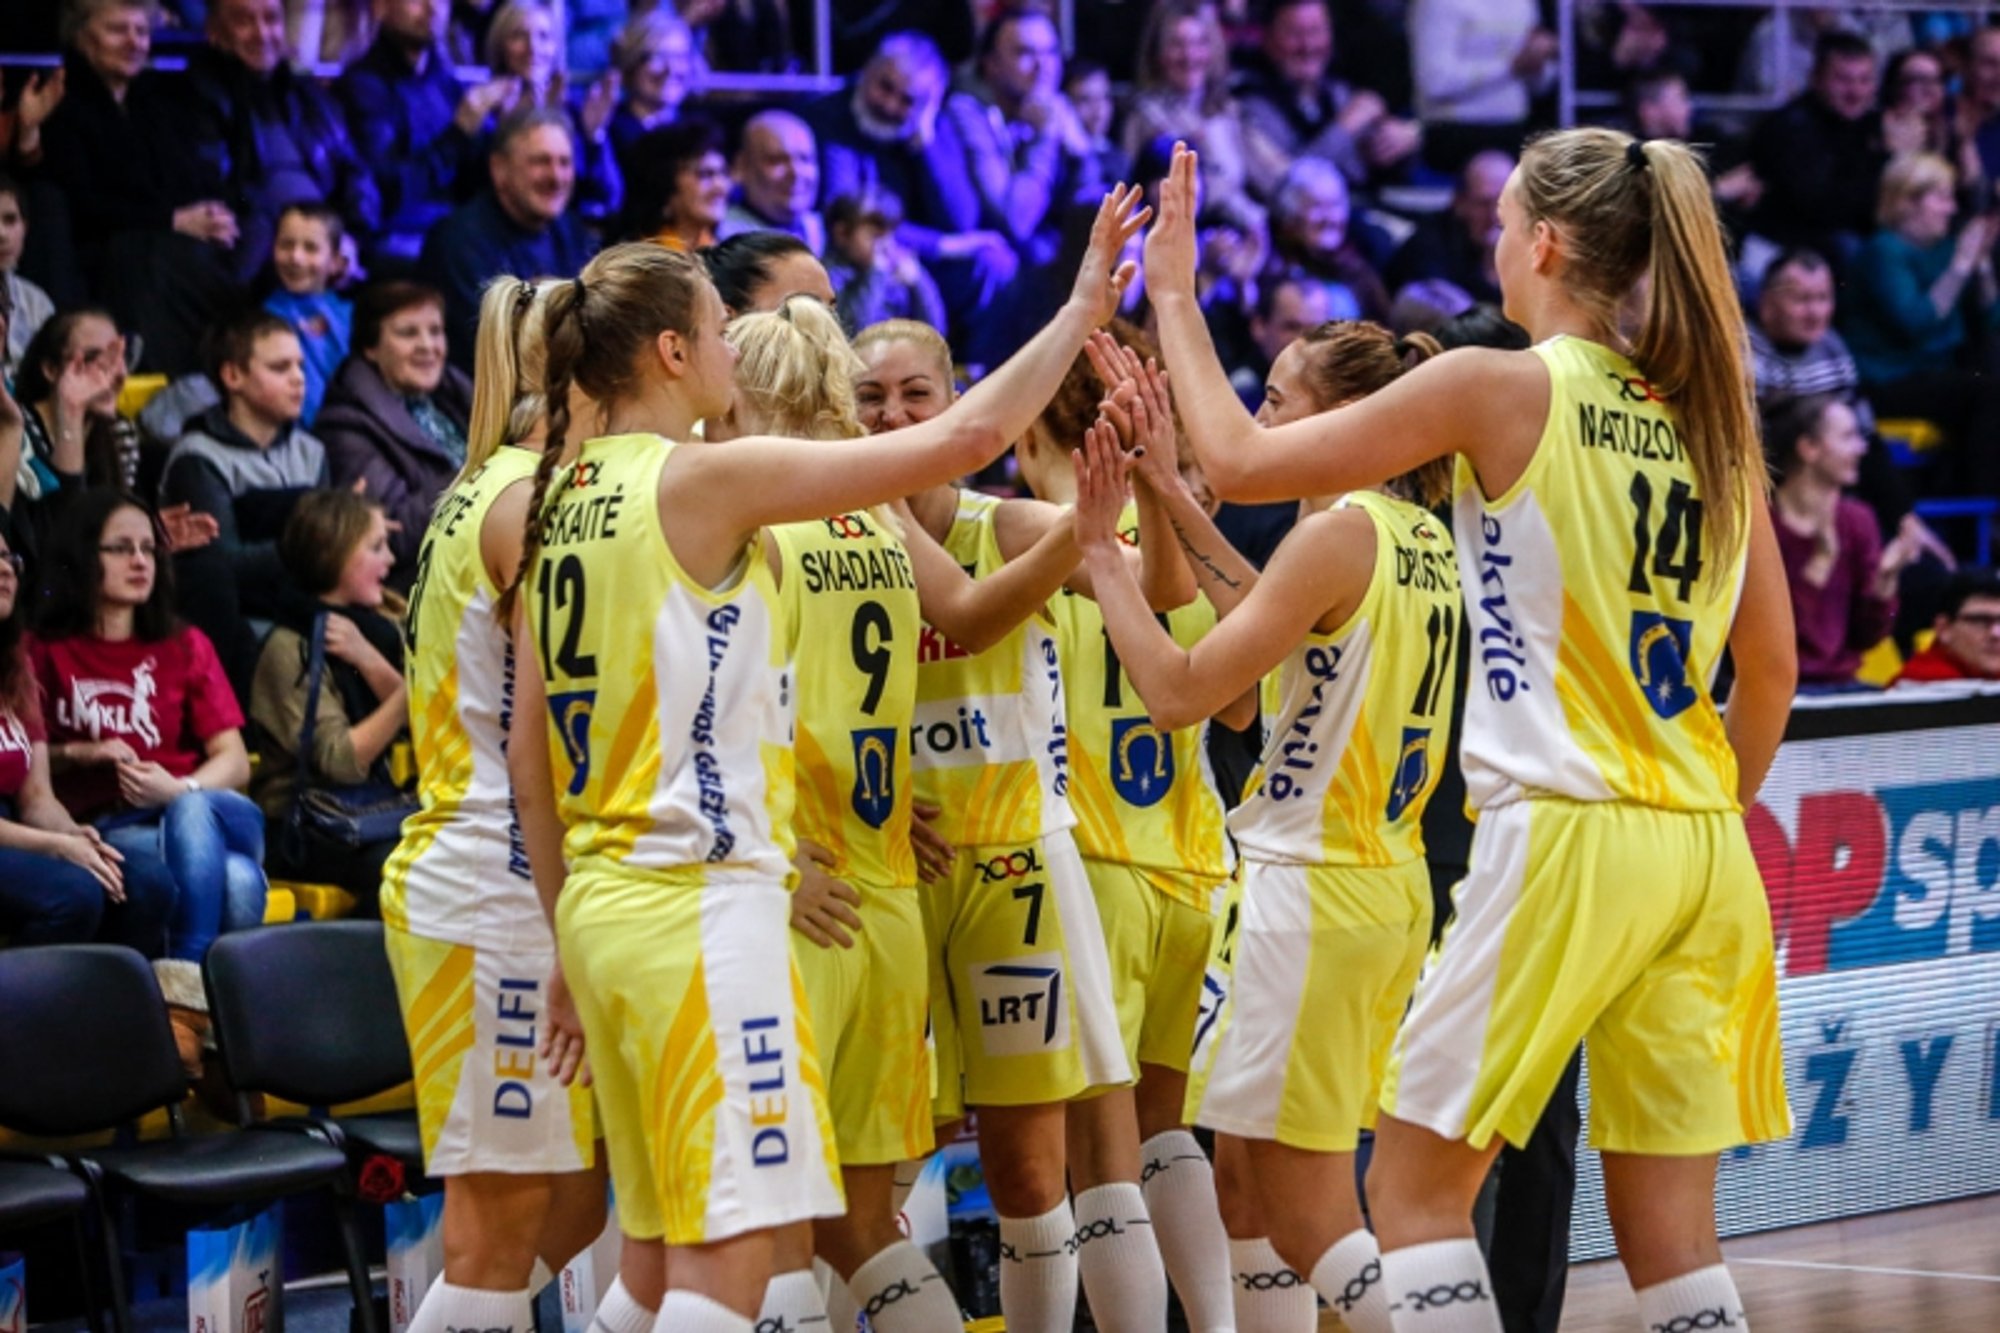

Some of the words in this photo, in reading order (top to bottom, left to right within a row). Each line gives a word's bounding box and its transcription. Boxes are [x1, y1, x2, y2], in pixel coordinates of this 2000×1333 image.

[541, 483, 624, 547] SKAITĖ
[1627, 470, 1703, 603] 14
[538, 553, 598, 681] 12
[852, 600, 893, 716] 9
[1410, 604, 1454, 717] 11
[910, 706, 991, 754] roit
[1012, 882, 1044, 945] 7
[493, 978, 538, 1119] DELFI
[981, 991, 1045, 1026] LRT
[741, 1016, 790, 1168] DELFI
